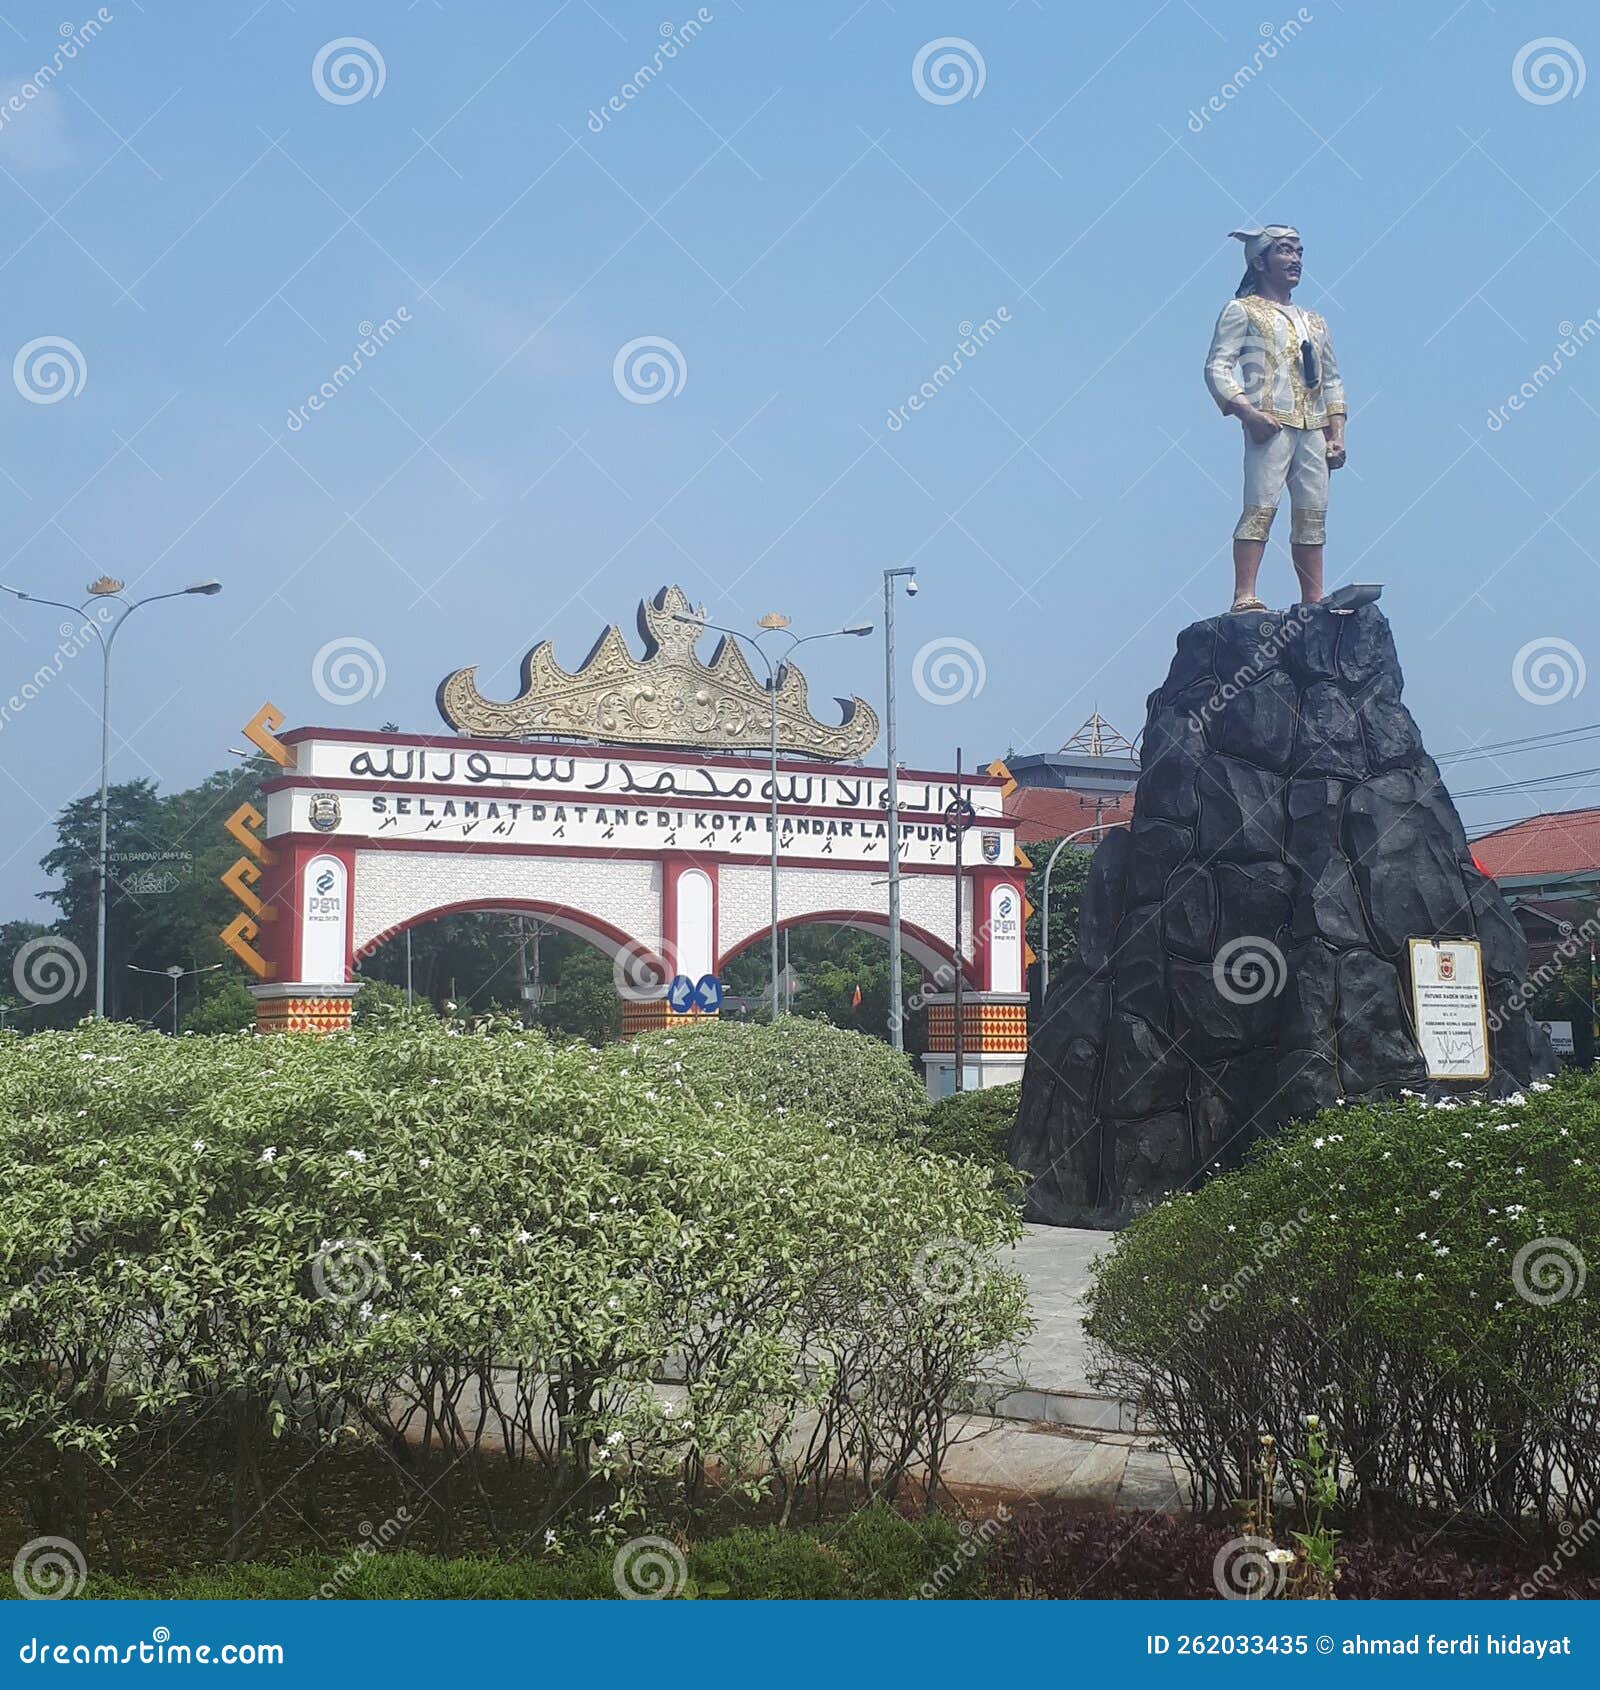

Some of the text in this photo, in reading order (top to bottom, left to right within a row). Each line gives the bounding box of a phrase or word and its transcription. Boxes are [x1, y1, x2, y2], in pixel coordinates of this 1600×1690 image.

[372, 796, 522, 820] SELAMAT
[532, 805, 650, 826] DATANG
[657, 811, 683, 828] DI
[694, 813, 757, 832] KOTA
[860, 822, 957, 843] LAPUNG
[309, 897, 340, 913] pgn
[994, 920, 1015, 934] pgn
